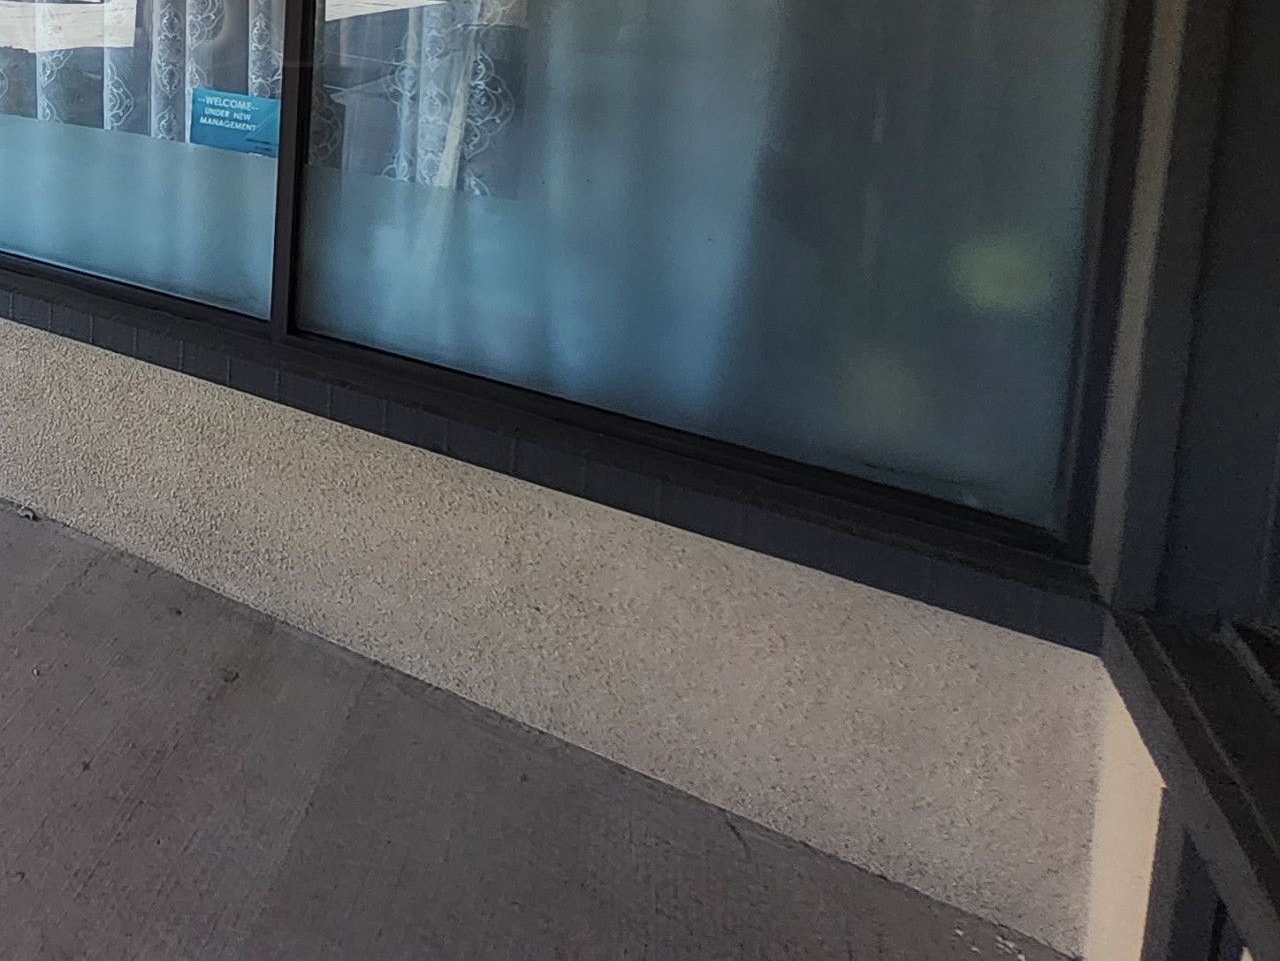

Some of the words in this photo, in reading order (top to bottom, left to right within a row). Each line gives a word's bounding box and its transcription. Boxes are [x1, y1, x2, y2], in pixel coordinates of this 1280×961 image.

[204, 107, 230, 118] UNDER
[233, 112, 252, 121] NEW
[200, 116, 256, 131] MANAGEMENT
